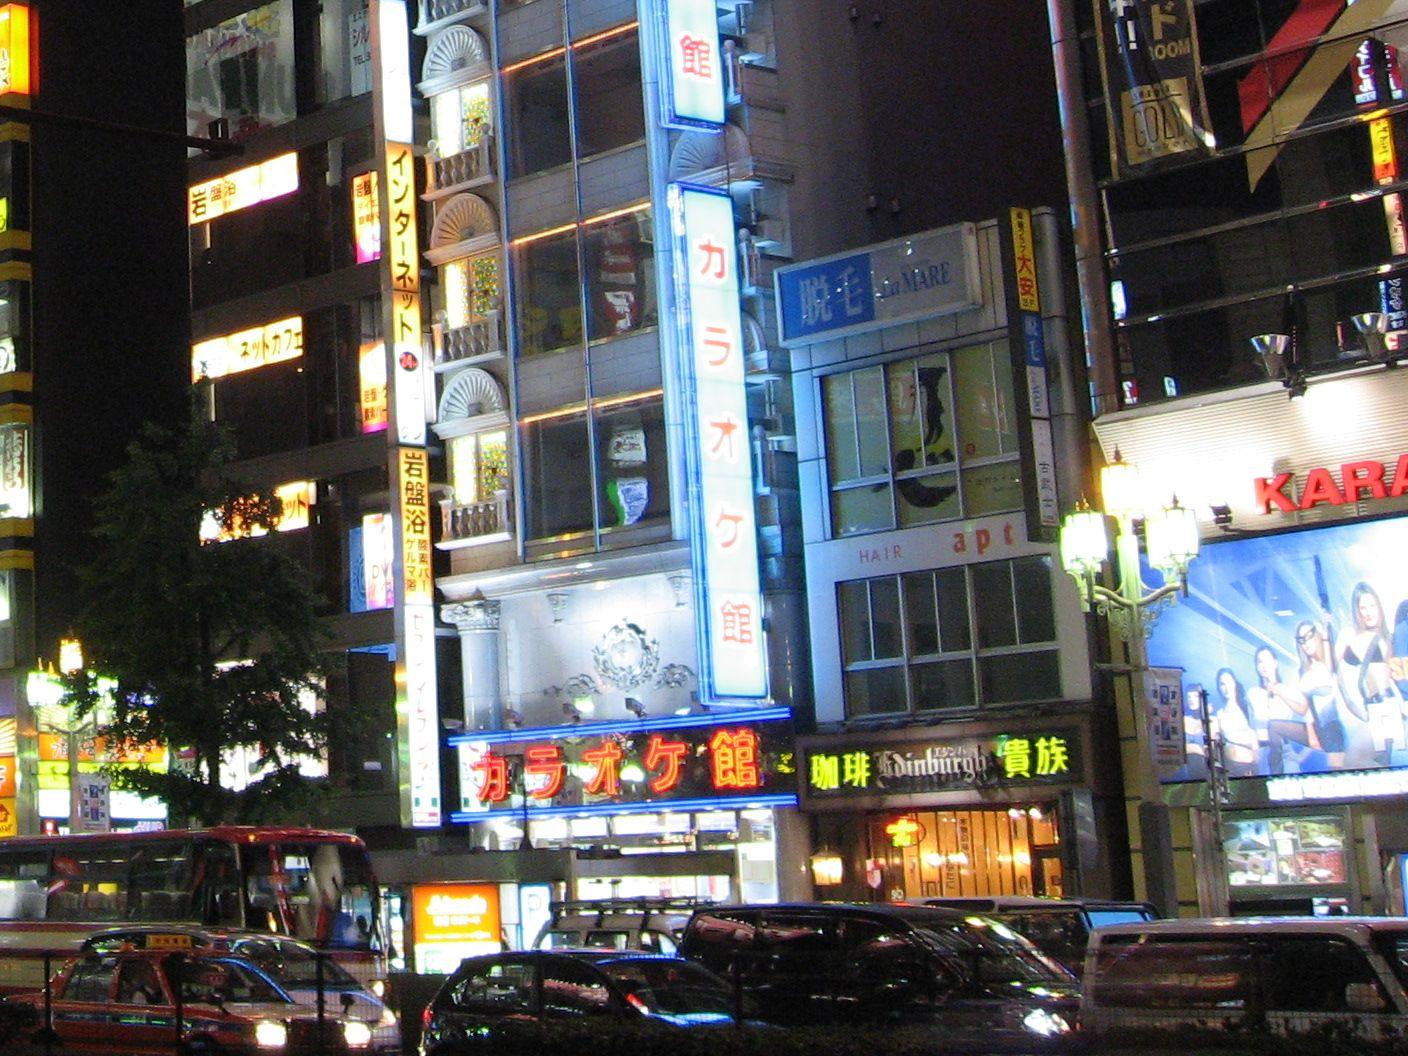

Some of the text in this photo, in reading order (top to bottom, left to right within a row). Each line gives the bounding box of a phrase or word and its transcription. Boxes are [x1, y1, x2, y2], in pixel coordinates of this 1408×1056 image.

[392, 149, 415, 343] インターネット
[900, 260, 953, 296] MARE
[798, 264, 866, 329] 脱毛
[697, 242, 753, 646] カラオケ館
[403, 452, 427, 535] 岩盤浴
[858, 544, 903, 565] HAIR
[472, 729, 760, 803] カラオケ館
[809, 751, 872, 791] 珈琲
[1004, 736, 1069, 779] 貴族
